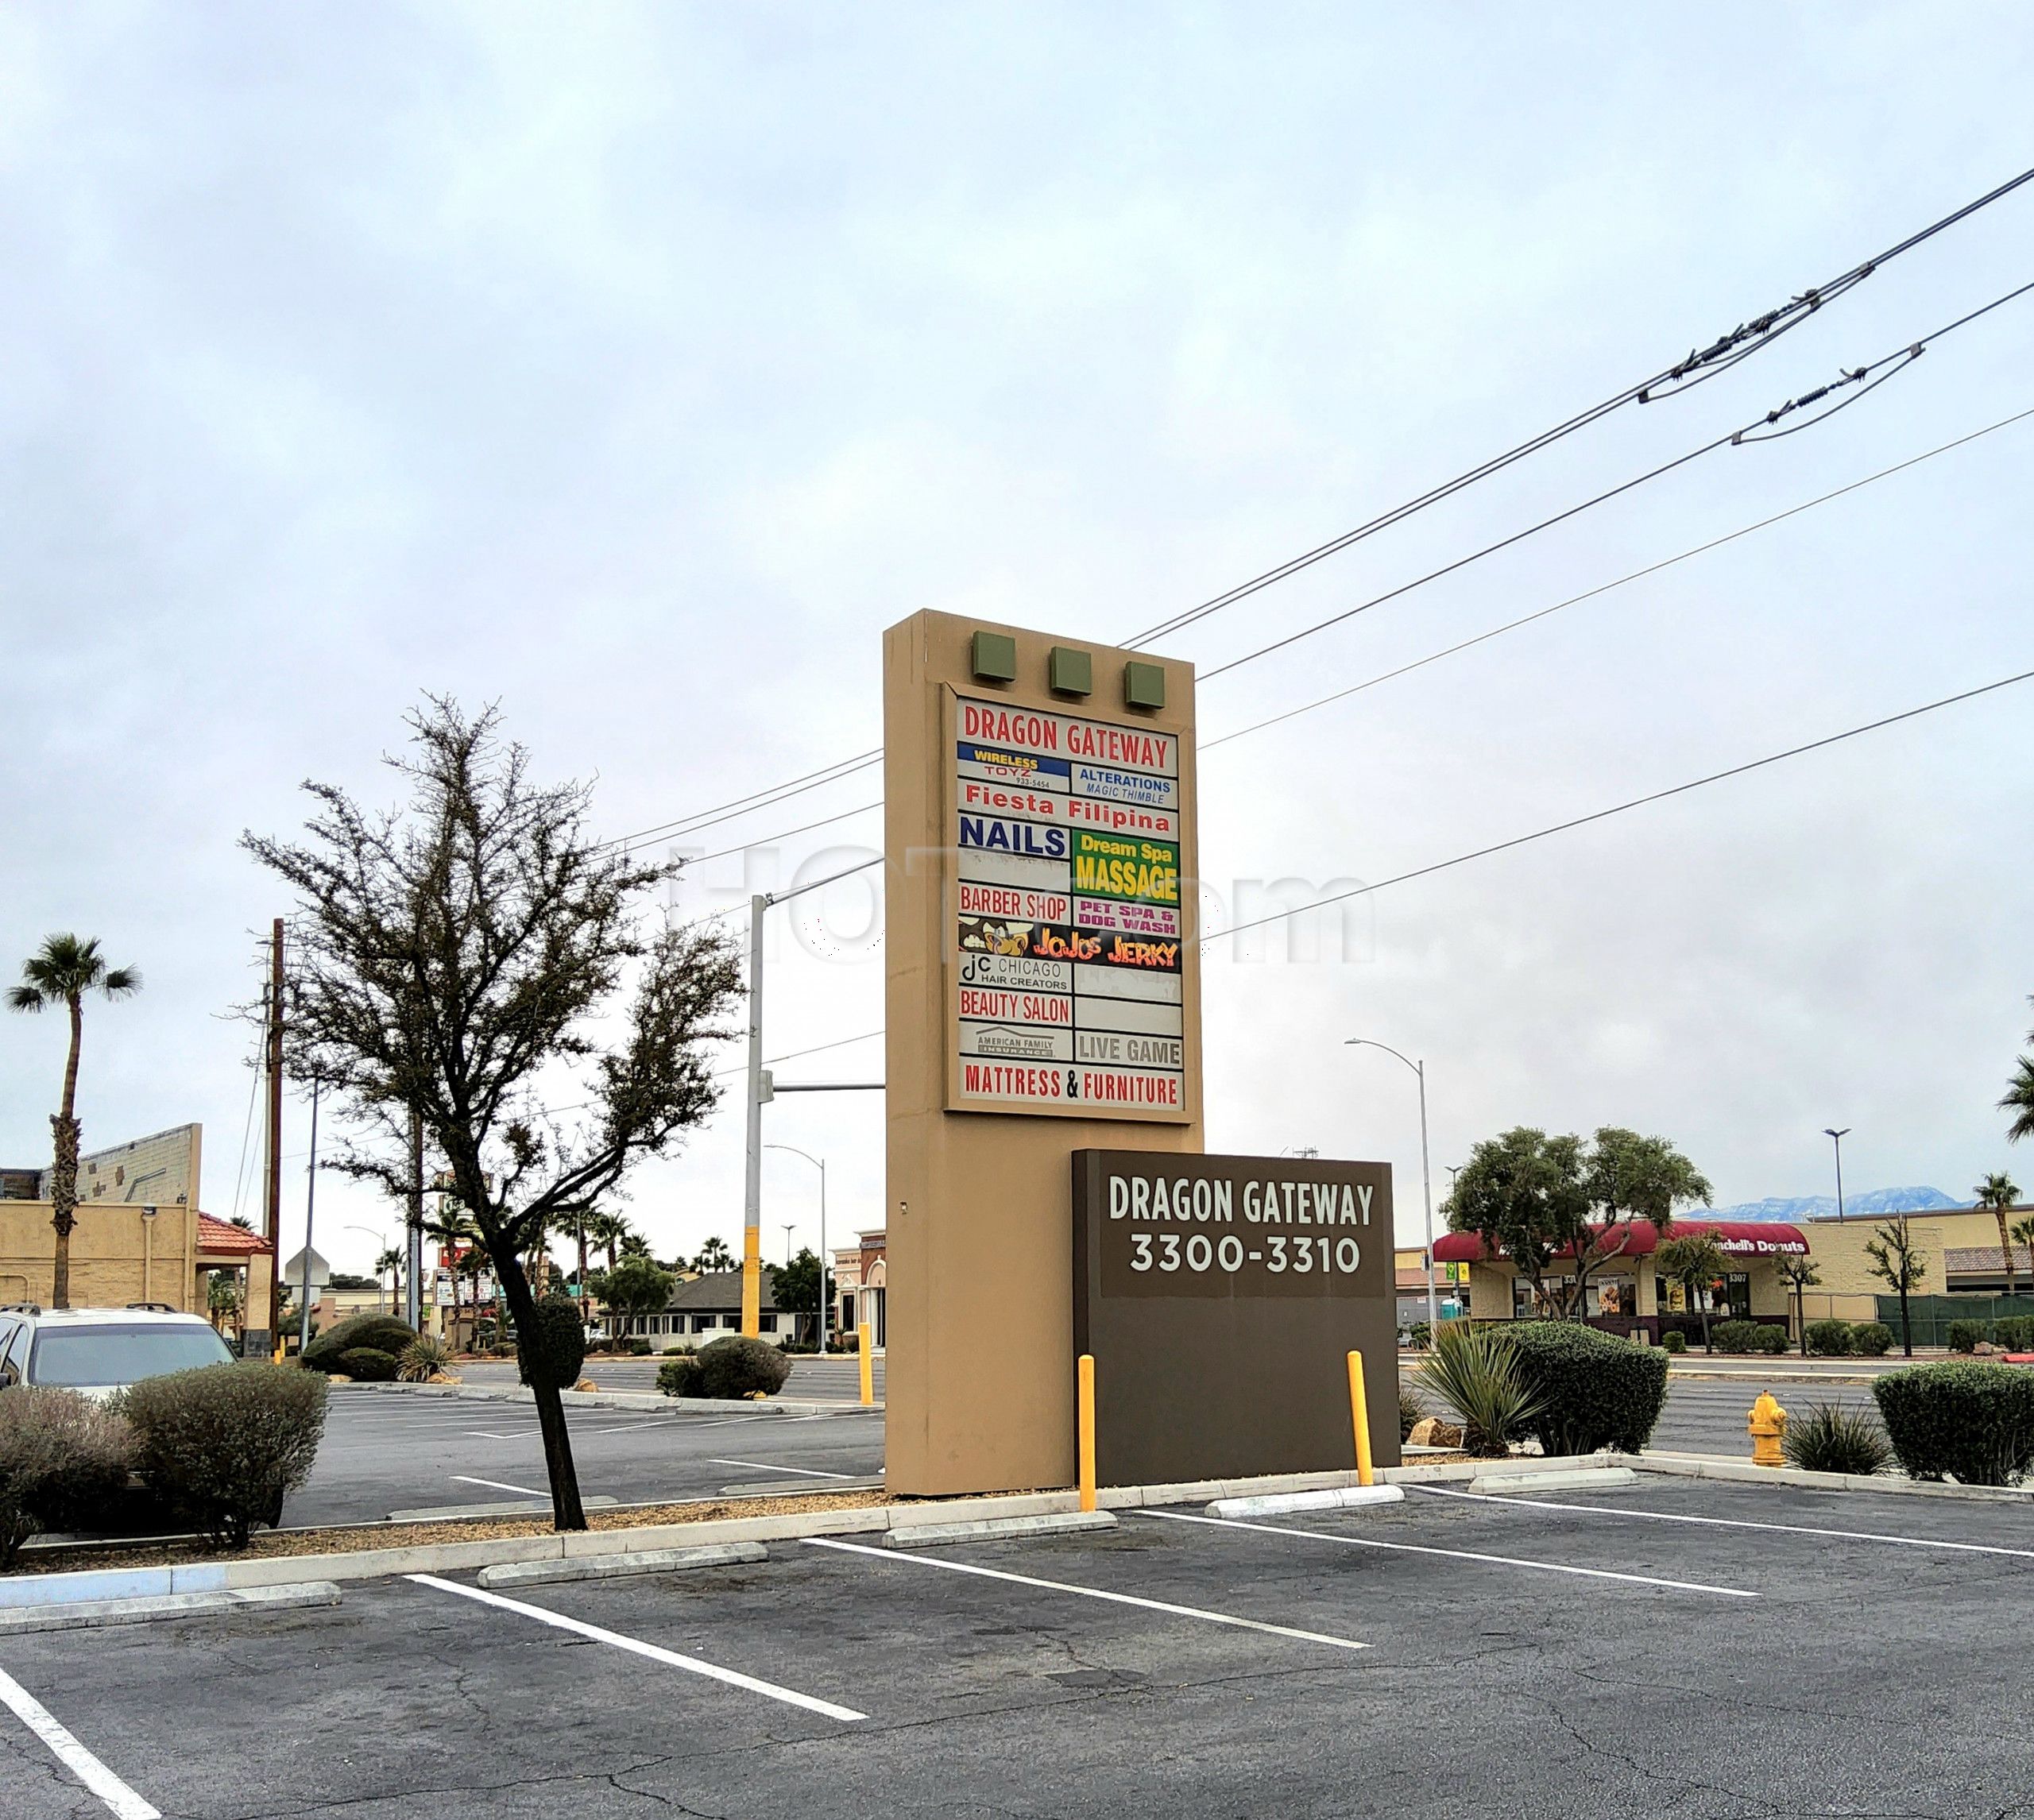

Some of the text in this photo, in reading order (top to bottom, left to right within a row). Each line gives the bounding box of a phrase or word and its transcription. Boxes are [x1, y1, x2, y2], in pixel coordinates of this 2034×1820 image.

[965, 705, 1167, 768] DRAGON GATEWAY
[974, 750, 1038, 770] WIRELESS
[984, 766, 1031, 777] TOYZ
[1015, 777, 1050, 788] 933-5454
[1080, 768, 1170, 793] ALTERATIONS
[1086, 782, 1165, 805] MAGIC THIMBLE
[966, 784, 1170, 832] Fiesta Filipina
[960, 816, 1065, 856] NAILS
[1081, 834, 1173, 864] Dream Spa
[1076, 856, 1177, 901] MASSAGE
[961, 886, 1066, 921] BARBER SHOP
[1081, 900, 1174, 922] PET SPA &
[1078, 914, 1176, 935] DOG WASH
[1108, 936, 1178, 967] JERKY
[981, 974, 1067, 990] HAIR CREATORS
[999, 958, 1061, 978] CHICAGO
[961, 990, 1069, 1023] BEAUTY SALON
[978, 1036, 1054, 1049] AMERICAN FAMILY
[983, 1045, 1050, 1056] INSURANCE
[1079, 1036, 1180, 1065] LIVE GAME
[965, 1065, 1177, 1105] MATTRESS & FURNITURE
[1109, 1176, 1374, 1226] DRAGON GATEWAY
[1130, 1234, 1360, 1273] 3300-3310
